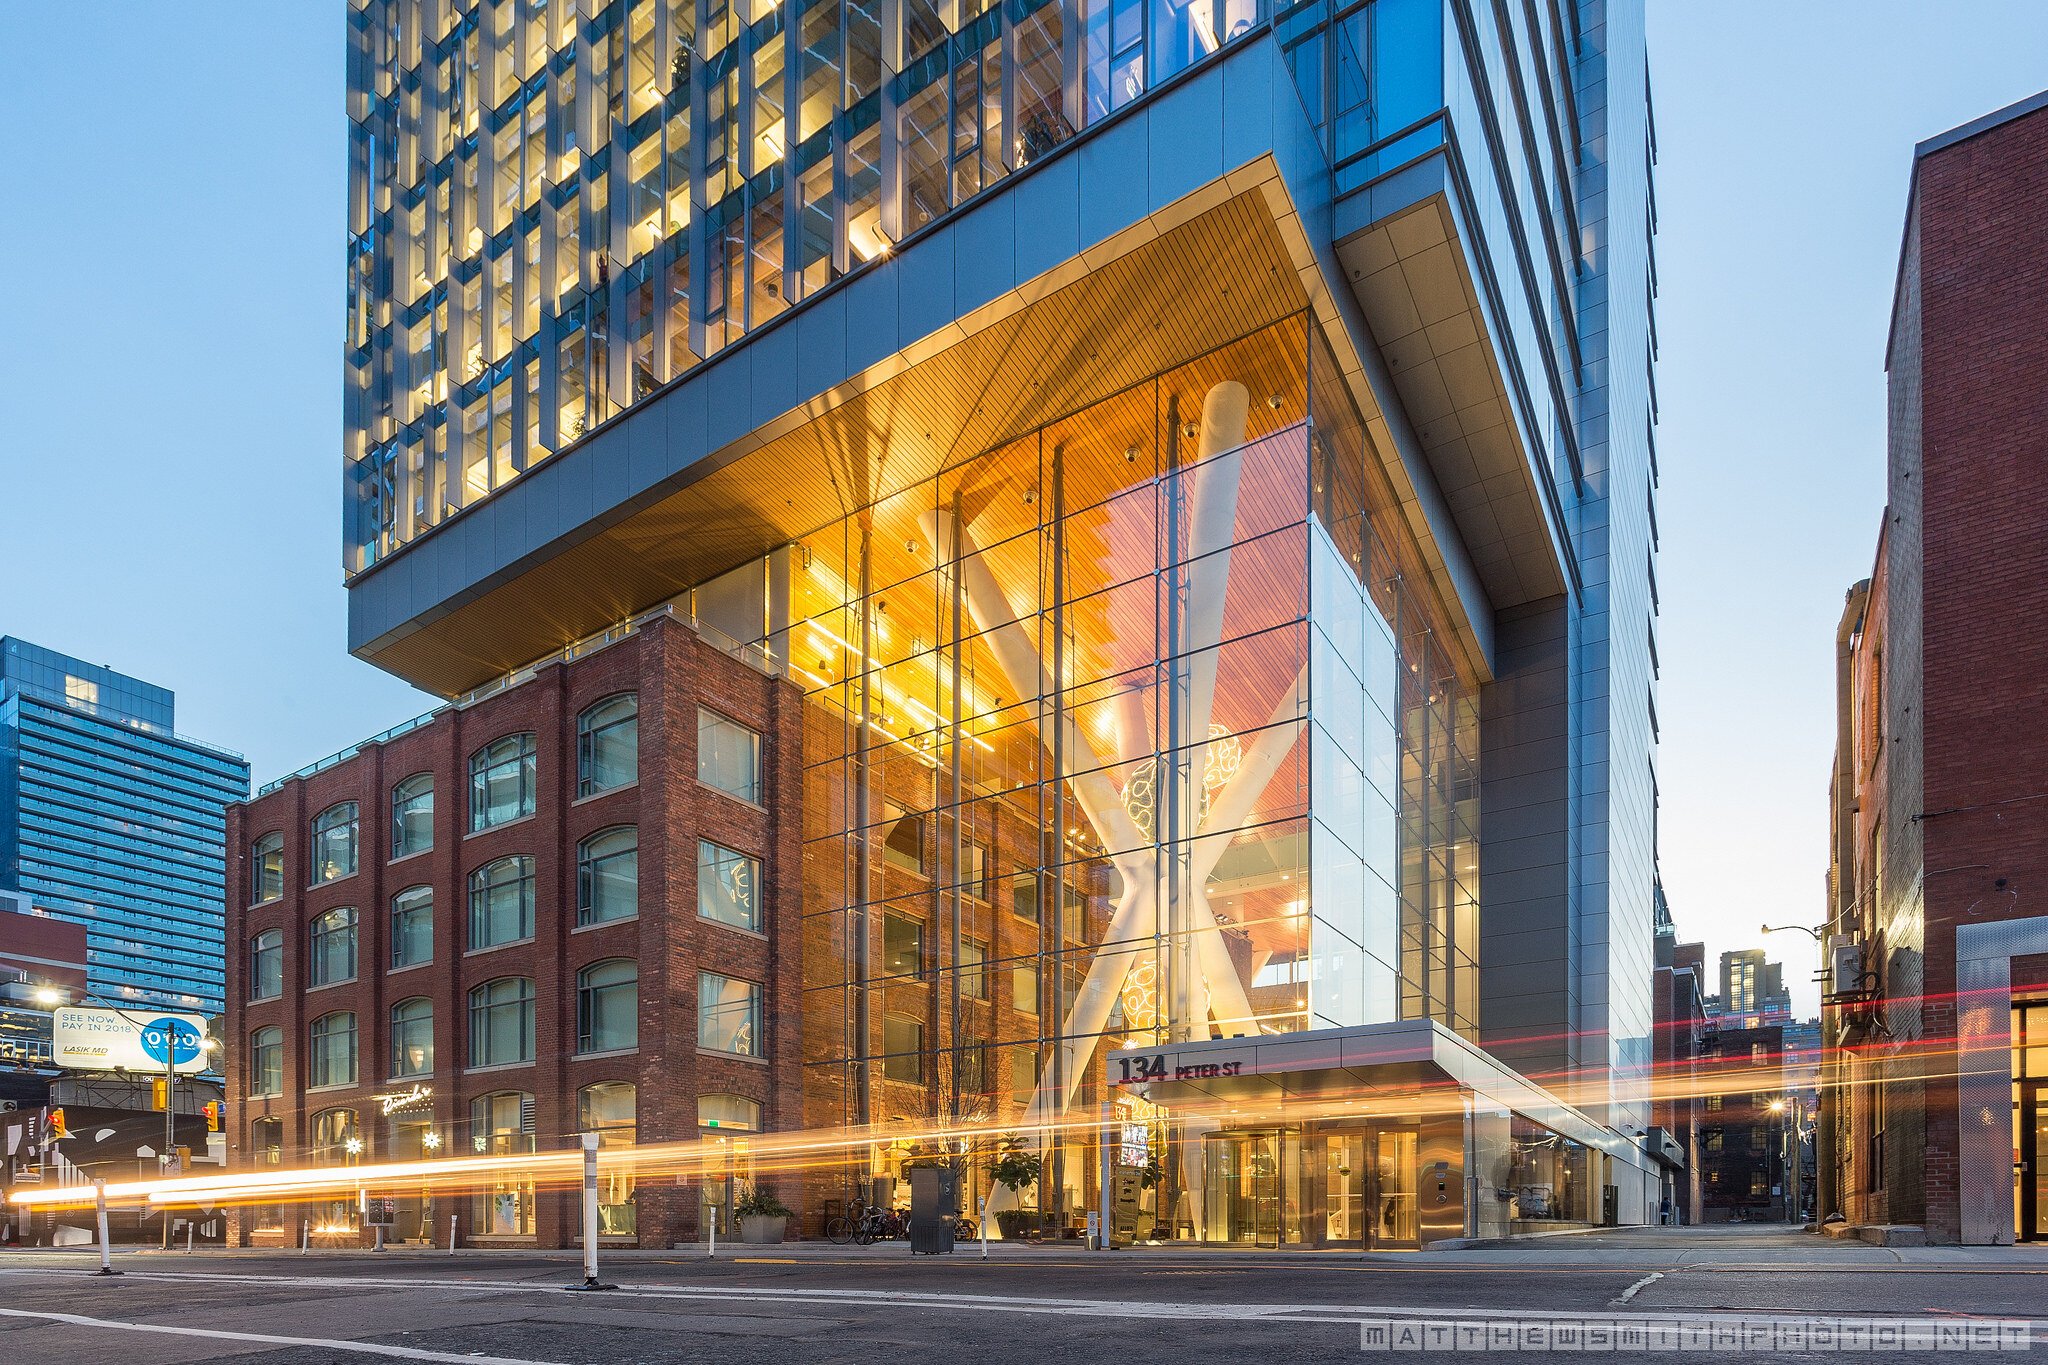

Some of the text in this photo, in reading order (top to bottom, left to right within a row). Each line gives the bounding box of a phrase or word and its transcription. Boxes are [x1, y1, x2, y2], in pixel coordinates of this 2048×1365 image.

[62, 1013, 83, 1022] SEE
[61, 1021, 84, 1030] PAY
[88, 1023, 101, 1031] IN
[1118, 1054, 1243, 1085] 134 PETER ST
